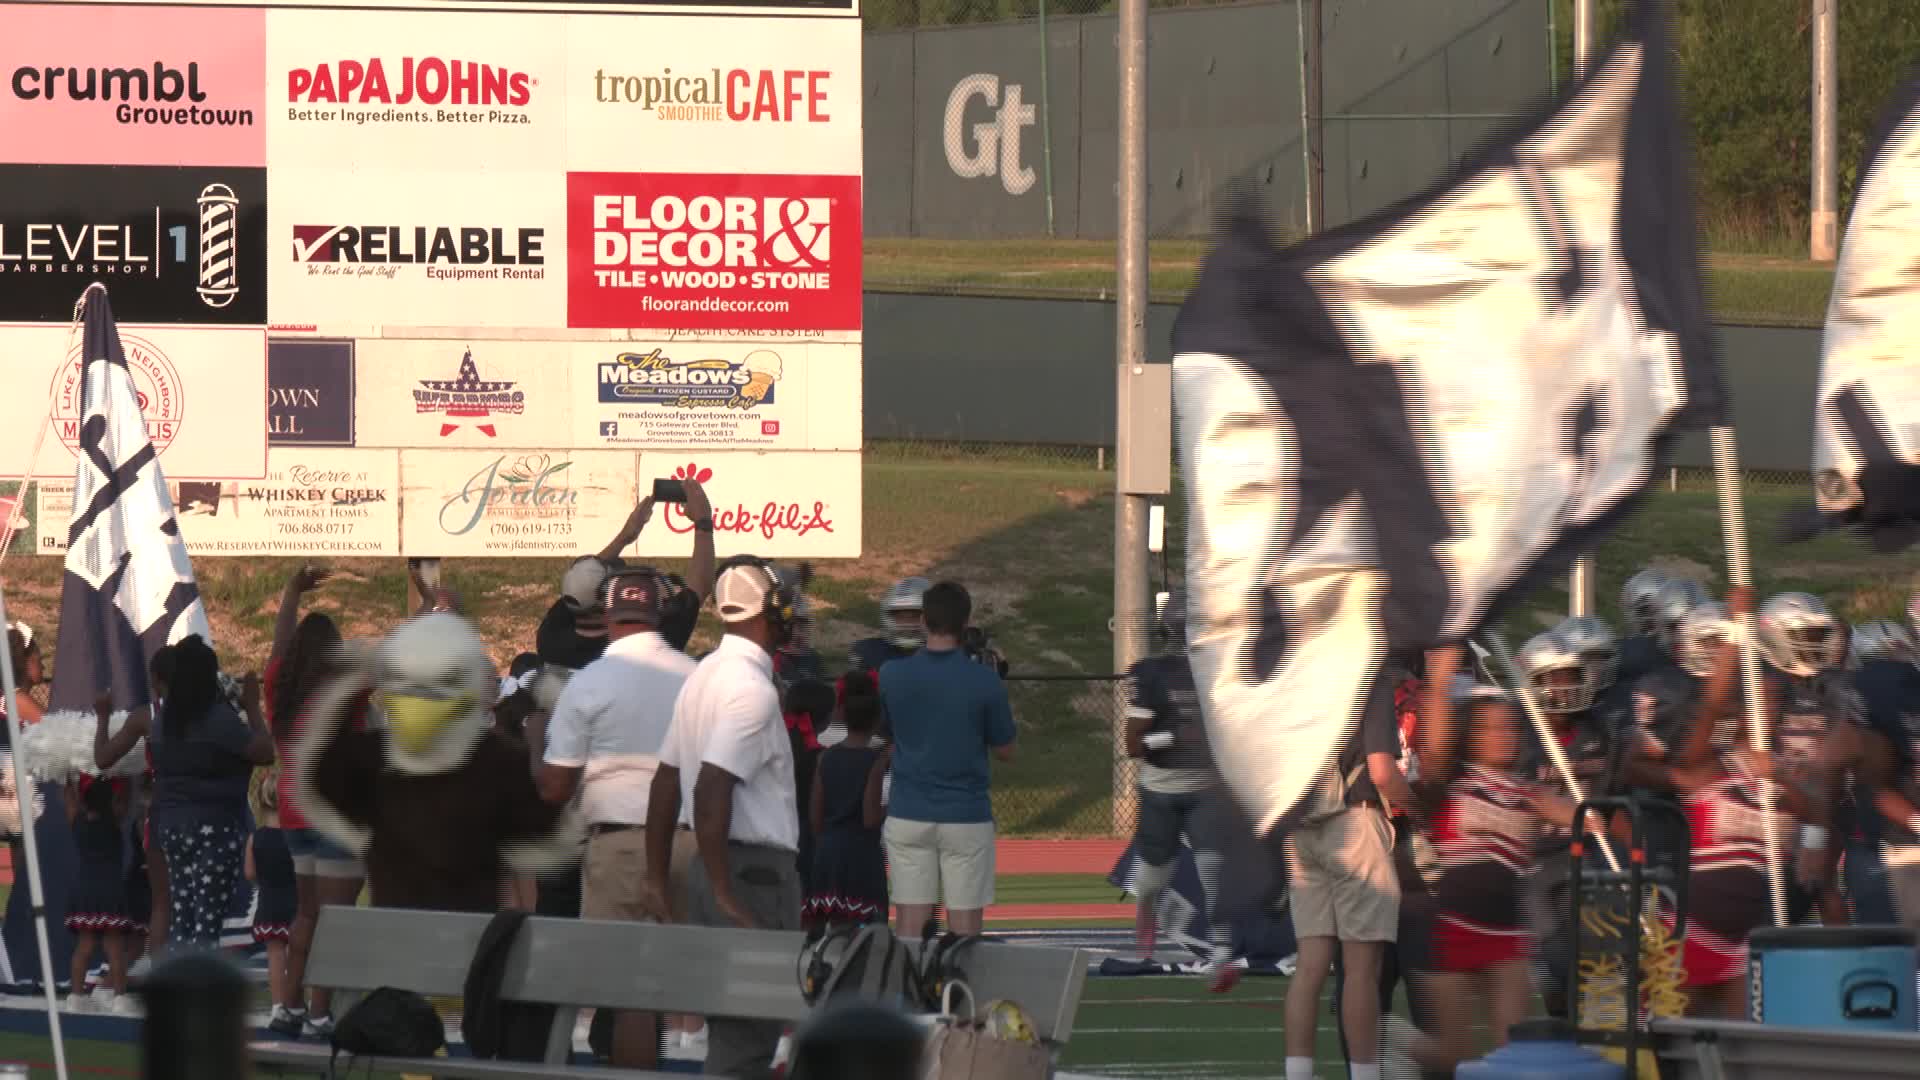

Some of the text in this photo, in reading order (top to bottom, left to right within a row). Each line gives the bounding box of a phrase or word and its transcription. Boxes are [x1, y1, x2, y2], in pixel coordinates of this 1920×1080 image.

[11, 61, 206, 102] crumbl
[288, 56, 530, 106] PAPA JOHNS
[594, 68, 723, 110] tropical
[726, 68, 831, 122] CAFE
[116, 104, 253, 126] Grovetown
[288, 108, 531, 125] Better Ingredients. Better Pizza.
[657, 106, 722, 121] SMOOTHIE
[593, 195, 757, 231] FLOOR
[0, 224, 187, 262] LEVEL 1
[331, 225, 544, 265] RELIABLE
[593, 232, 757, 267] DECOR
[0, 264, 147, 273] BARBERSHOP
[427, 267, 544, 281] Equipment Rental
[594, 270, 830, 289] TILE WOOD STONE
[641, 296, 789, 312] flooranddecor.com
[617, 348, 671, 370] The
[131, 347, 170, 419] NEIGHBOR
[600, 365, 752, 385] Meadows
[618, 411, 761, 421] meadowsofgrovetown.com
[656, 421, 690, 430] Gateway
[289, 465, 351, 486] Reserve
[248, 487, 386, 501] WHISKEY CREEK
[439, 455, 578, 535] Jordan
[263, 509, 369, 518] APARTMENT HOMES
[664, 501, 834, 540] Cick-fil-A
[278, 523, 354, 535] 706.868.0717
[490, 523, 572, 535] (706) 619-1733
[485, 540, 578, 551] www.jfdentistry.com
